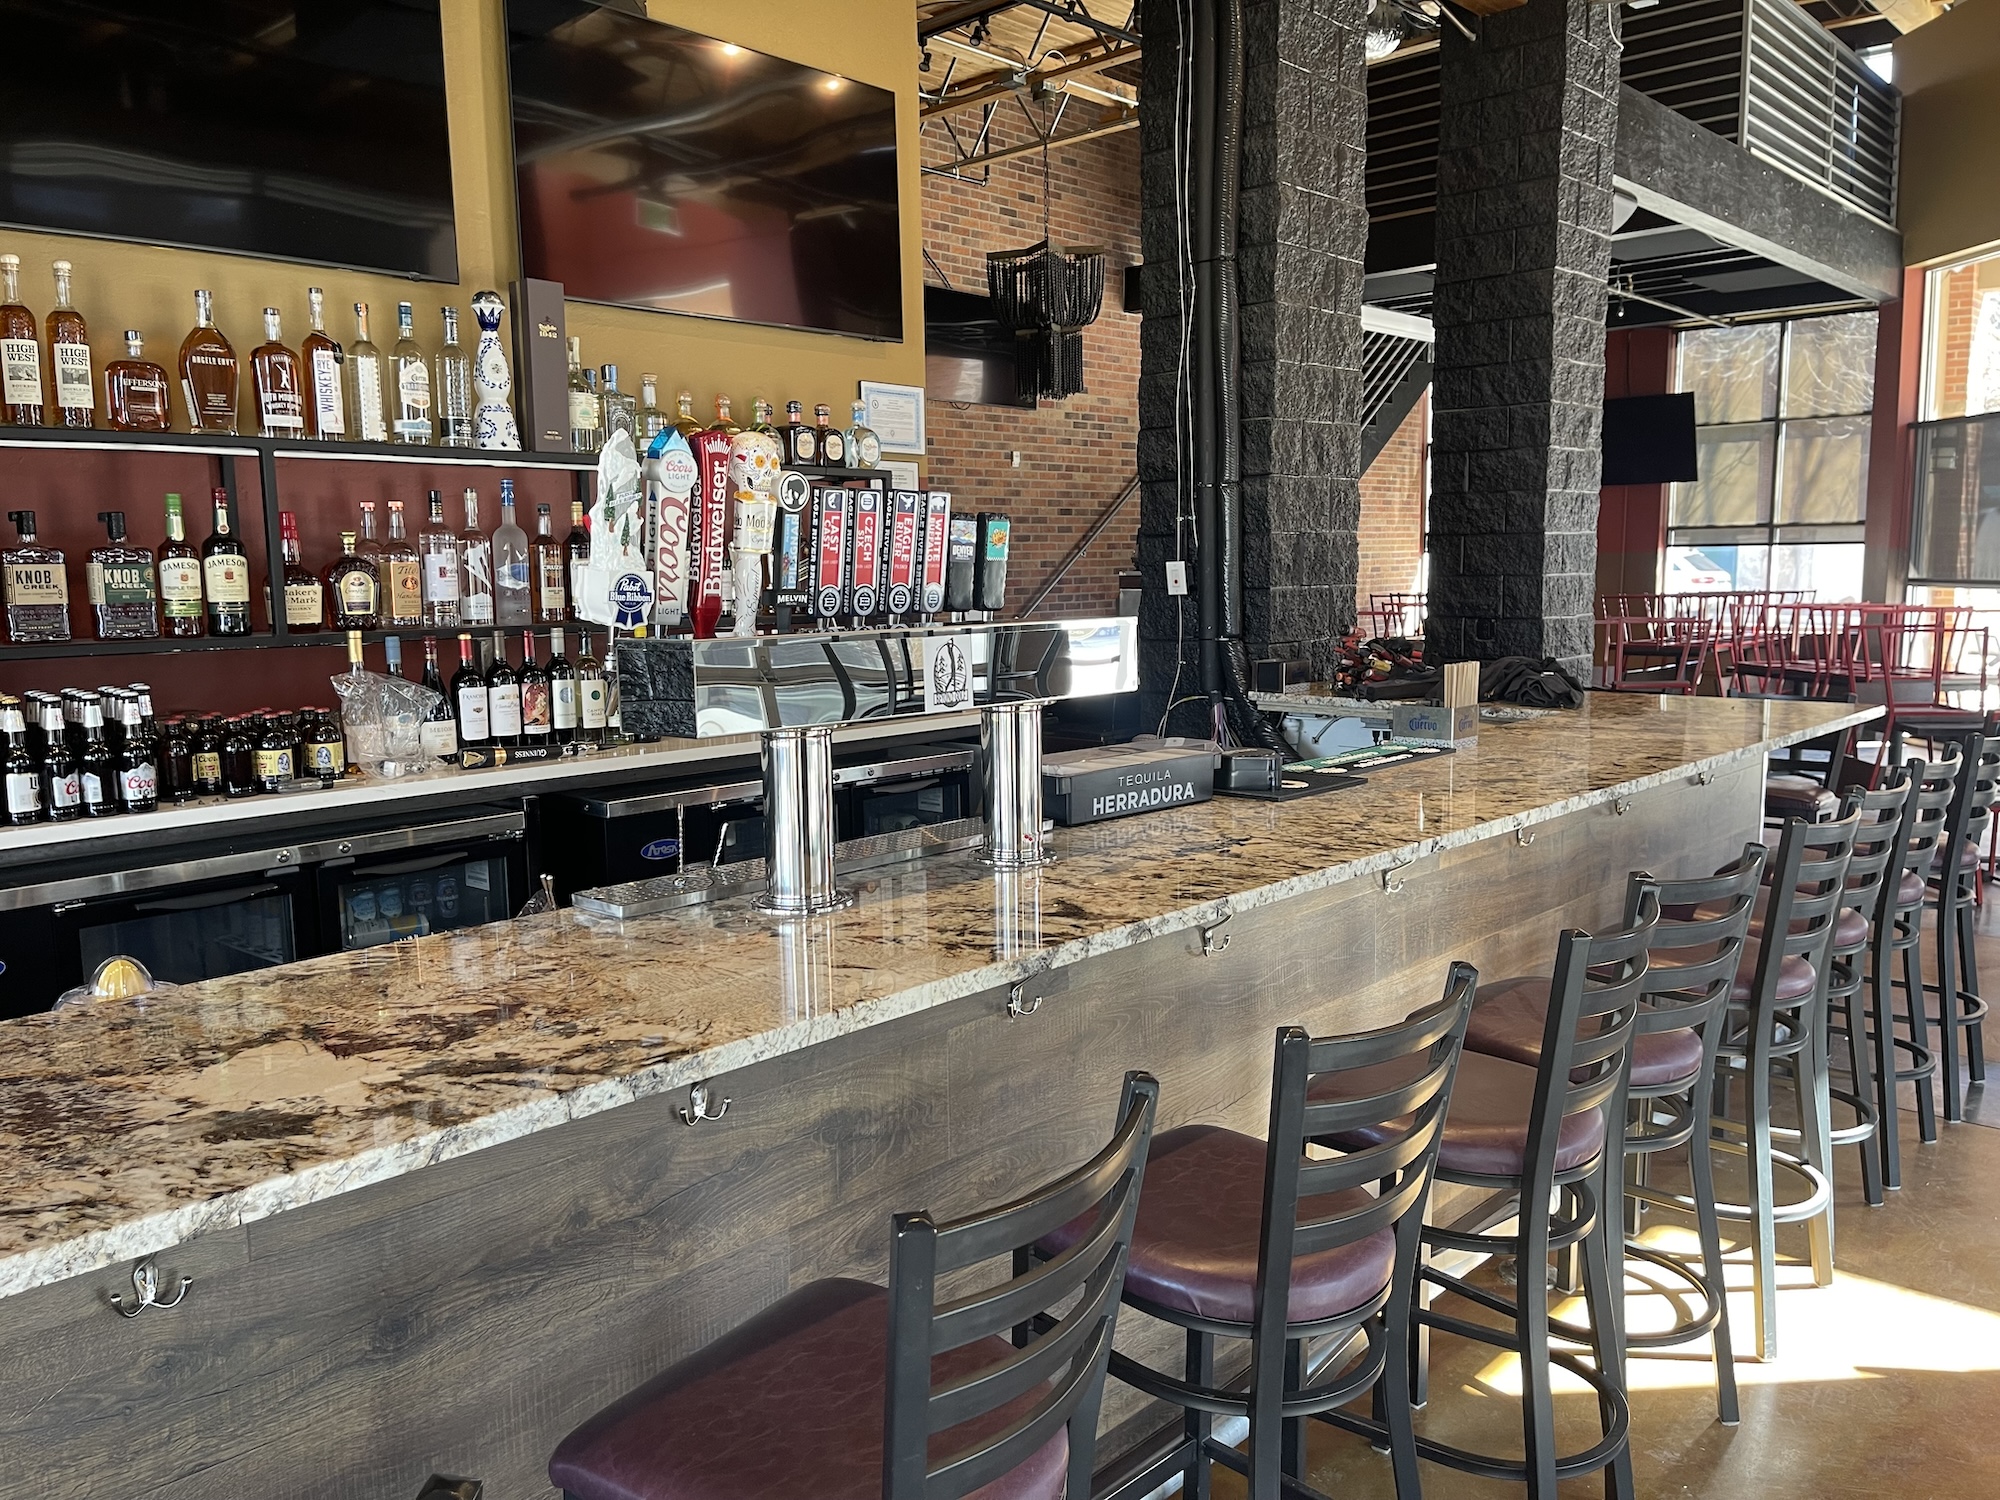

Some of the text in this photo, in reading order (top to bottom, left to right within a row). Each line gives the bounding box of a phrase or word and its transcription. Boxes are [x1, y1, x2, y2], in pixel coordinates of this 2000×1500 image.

[6, 343, 35, 353] HIGH
[60, 348, 87, 358] HIGH
[7, 353, 36, 362] WEST
[61, 357, 88, 366] WEST
[317, 359, 331, 369] RYE
[318, 369, 335, 412] WHISKEY
[666, 460, 693, 473] Coors
[919, 493, 927, 528] EAGLE
[823, 519, 831, 549] CAST
[830, 515, 840, 554] LAST
[863, 516, 873, 562] CZECH
[894, 521, 904, 557] RIVER
[901, 517, 912, 562] EAGLE
[927, 517, 936, 562] BUFFALO
[933, 518, 943, 562] WHITE
[658, 496, 689, 604] Coors
[807, 489, 820, 615] EAGLE RIVER BREWING
[878, 491, 893, 612] EAGLE RIVER BREWING
[952, 545, 974, 556] DENVER
[162, 561, 199, 572] JAMESON
[207, 558, 246, 569] JAMESON
[15, 570, 52, 584] KNOB
[104, 568, 140, 583] KNOB
[619, 578, 641, 591] Pabst
[843, 564, 851, 614] BREWING
[913, 562, 922, 611] BREWING
[57, 589, 63, 599] 9
[145, 589, 151, 599] 7
[609, 592, 651, 602] Blue Ribbon
[777, 594, 808, 604] MELVIN
[658, 607, 680, 615] LIGHT
[1408, 717, 1438, 732] Cuervo
[513, 748, 548, 759] GUINNESS
[127, 776, 156, 789] Coo
[1118, 770, 1172, 787] TEQUILA
[133, 789, 157, 798] LIGH
[1093, 781, 1195, 816] HERRADURA
